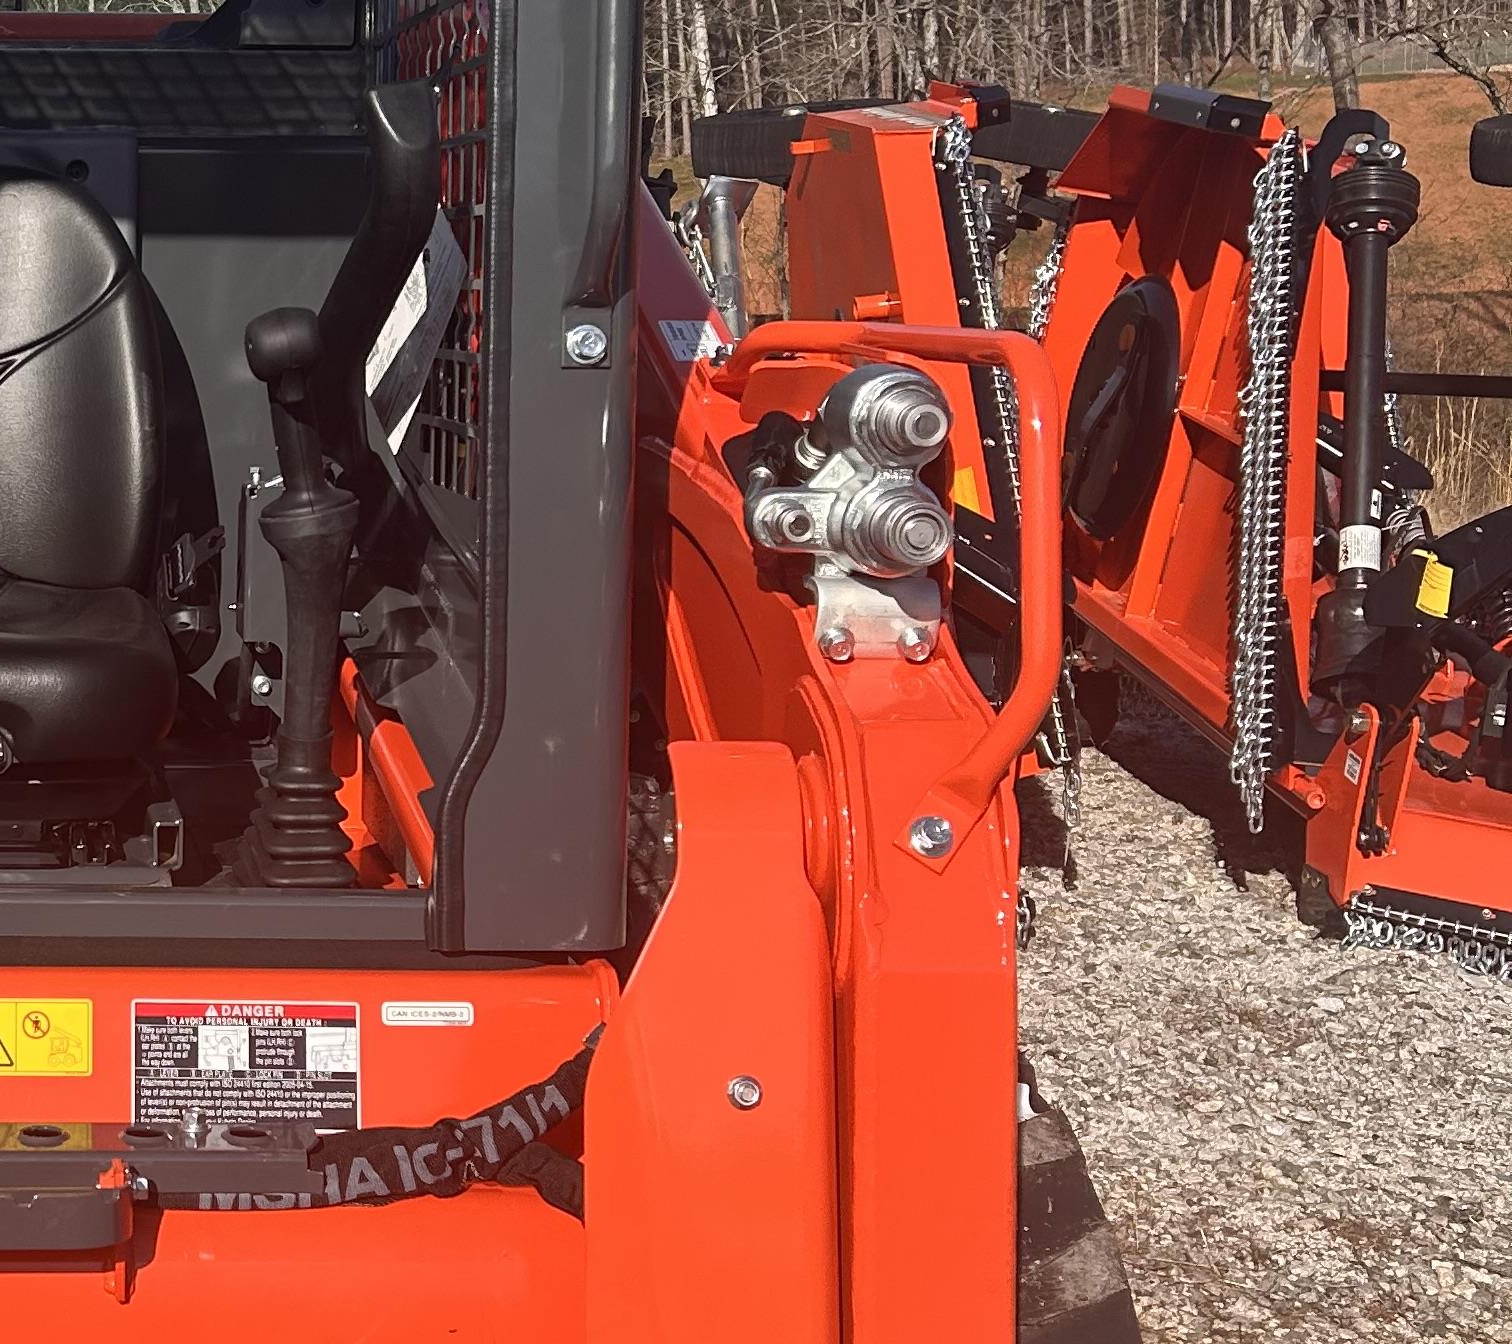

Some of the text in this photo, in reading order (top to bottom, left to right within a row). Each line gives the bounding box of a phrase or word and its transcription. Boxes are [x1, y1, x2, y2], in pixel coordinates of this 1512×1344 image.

[221, 1005, 285, 1017] DANGER
[166, 1017, 177, 1025] TO
[179, 1017, 204, 1025] AVOID
[206, 1017, 248, 1025] PERSONAL
[251, 1018, 279, 1026] INJURY
[281, 1018, 293, 1026] OR
